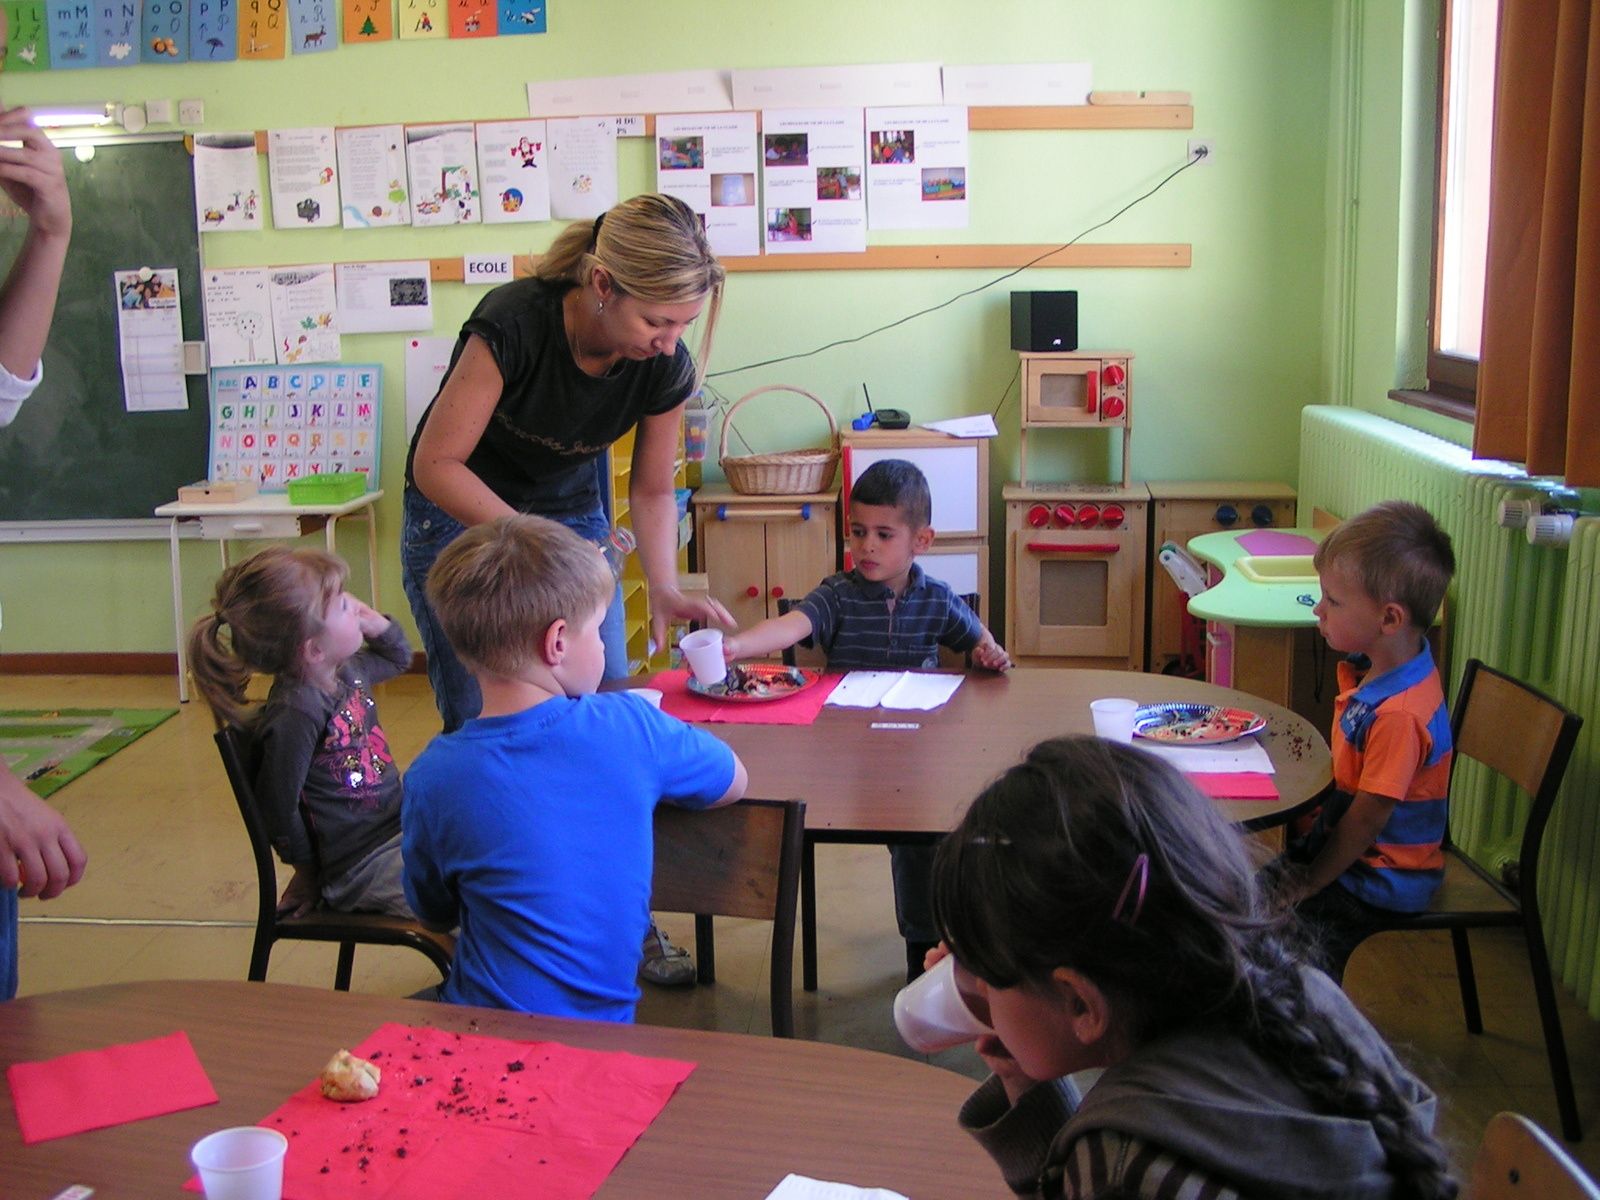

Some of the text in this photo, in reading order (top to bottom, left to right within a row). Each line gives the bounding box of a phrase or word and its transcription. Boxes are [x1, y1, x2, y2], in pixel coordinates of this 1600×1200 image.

[58, 6, 88, 19] m M
[104, 4, 134, 17] n N
[169, 1, 182, 14] O
[200, 0, 228, 16] p P
[251, 0, 259, 13] q
[469, 262, 507, 273] ECOLE
[245, 375, 257, 389] A
[268, 376, 279, 389] B
[290, 375, 302, 388] C
[336, 375, 346, 387] E
[360, 374, 370, 387] F
[222, 406, 233, 419] G
[244, 405, 254, 418] H
[290, 404, 299, 417] J
[312, 404, 323, 417] K
[336, 404, 345, 417] L
[358, 404, 370, 417] M
[221, 435, 232, 448] N
[243, 434, 254, 448] O
[267, 434, 277, 447] P
[289, 433, 300, 446] Q
[311, 433, 321, 446] R
[264, 464, 276, 477] W
[287, 463, 298, 476] X
[311, 464, 320, 474] Y
